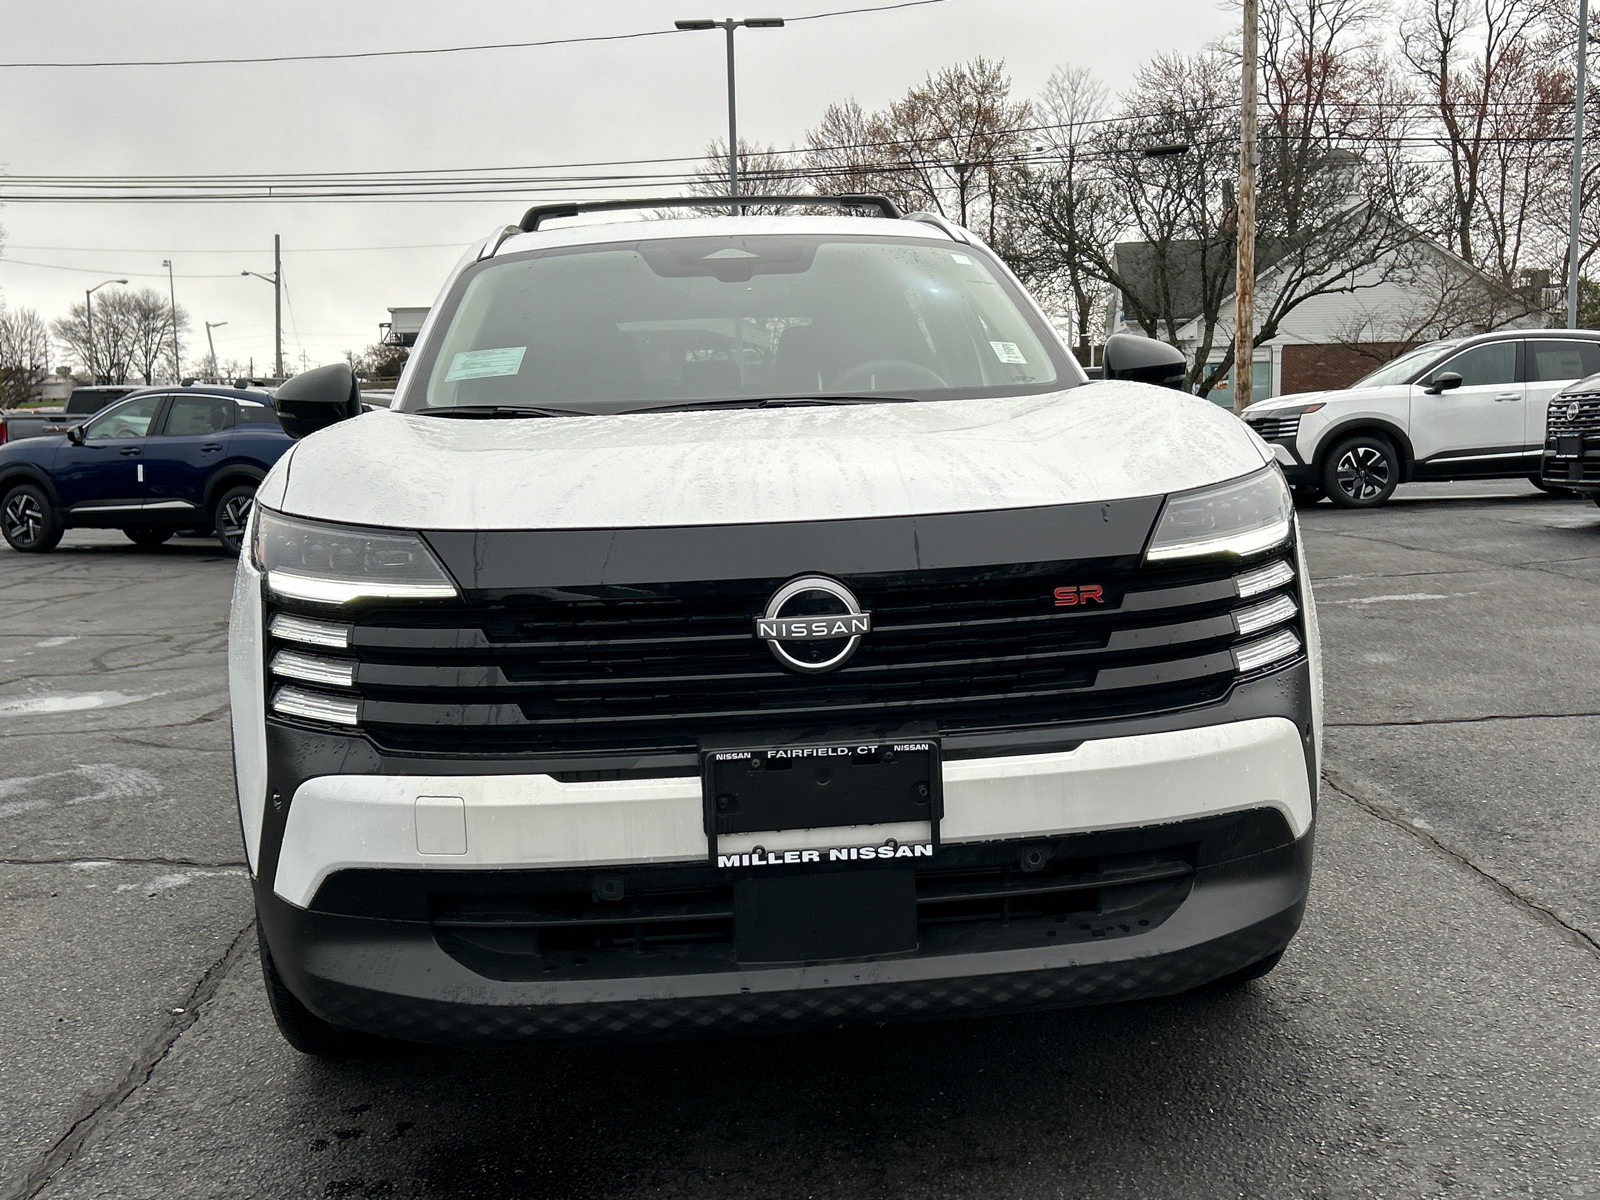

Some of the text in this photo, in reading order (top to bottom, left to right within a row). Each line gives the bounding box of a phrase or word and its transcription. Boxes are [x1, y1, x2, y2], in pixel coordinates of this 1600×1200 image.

[1053, 584, 1104, 607] SR
[759, 617, 869, 637] NISSAN
[715, 743, 929, 760] NISSAN FAIRFIELD, CT NISSAN
[717, 844, 933, 868] MILLER NISSAN
